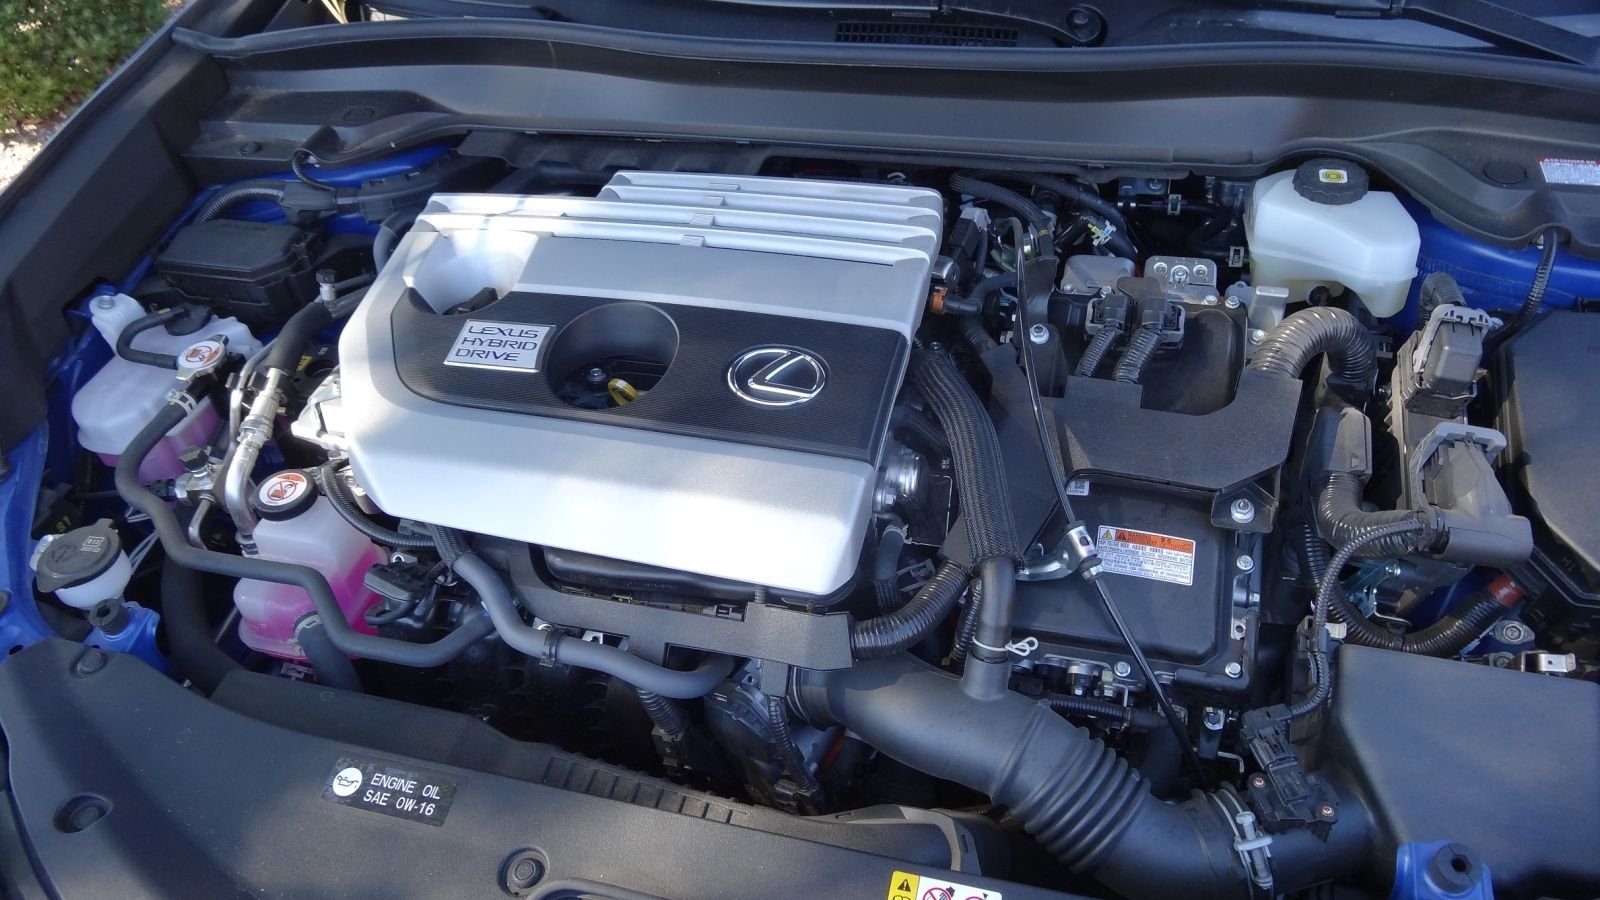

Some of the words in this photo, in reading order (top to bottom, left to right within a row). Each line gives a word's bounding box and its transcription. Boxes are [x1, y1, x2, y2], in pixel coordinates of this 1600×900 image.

[468, 326, 539, 338] LEXUS
[461, 337, 537, 350] HYBRID
[455, 348, 520, 361] DRIVE
[370, 773, 417, 794] ENGINE
[422, 784, 440, 800] OIL
[363, 789, 391, 806] SAE
